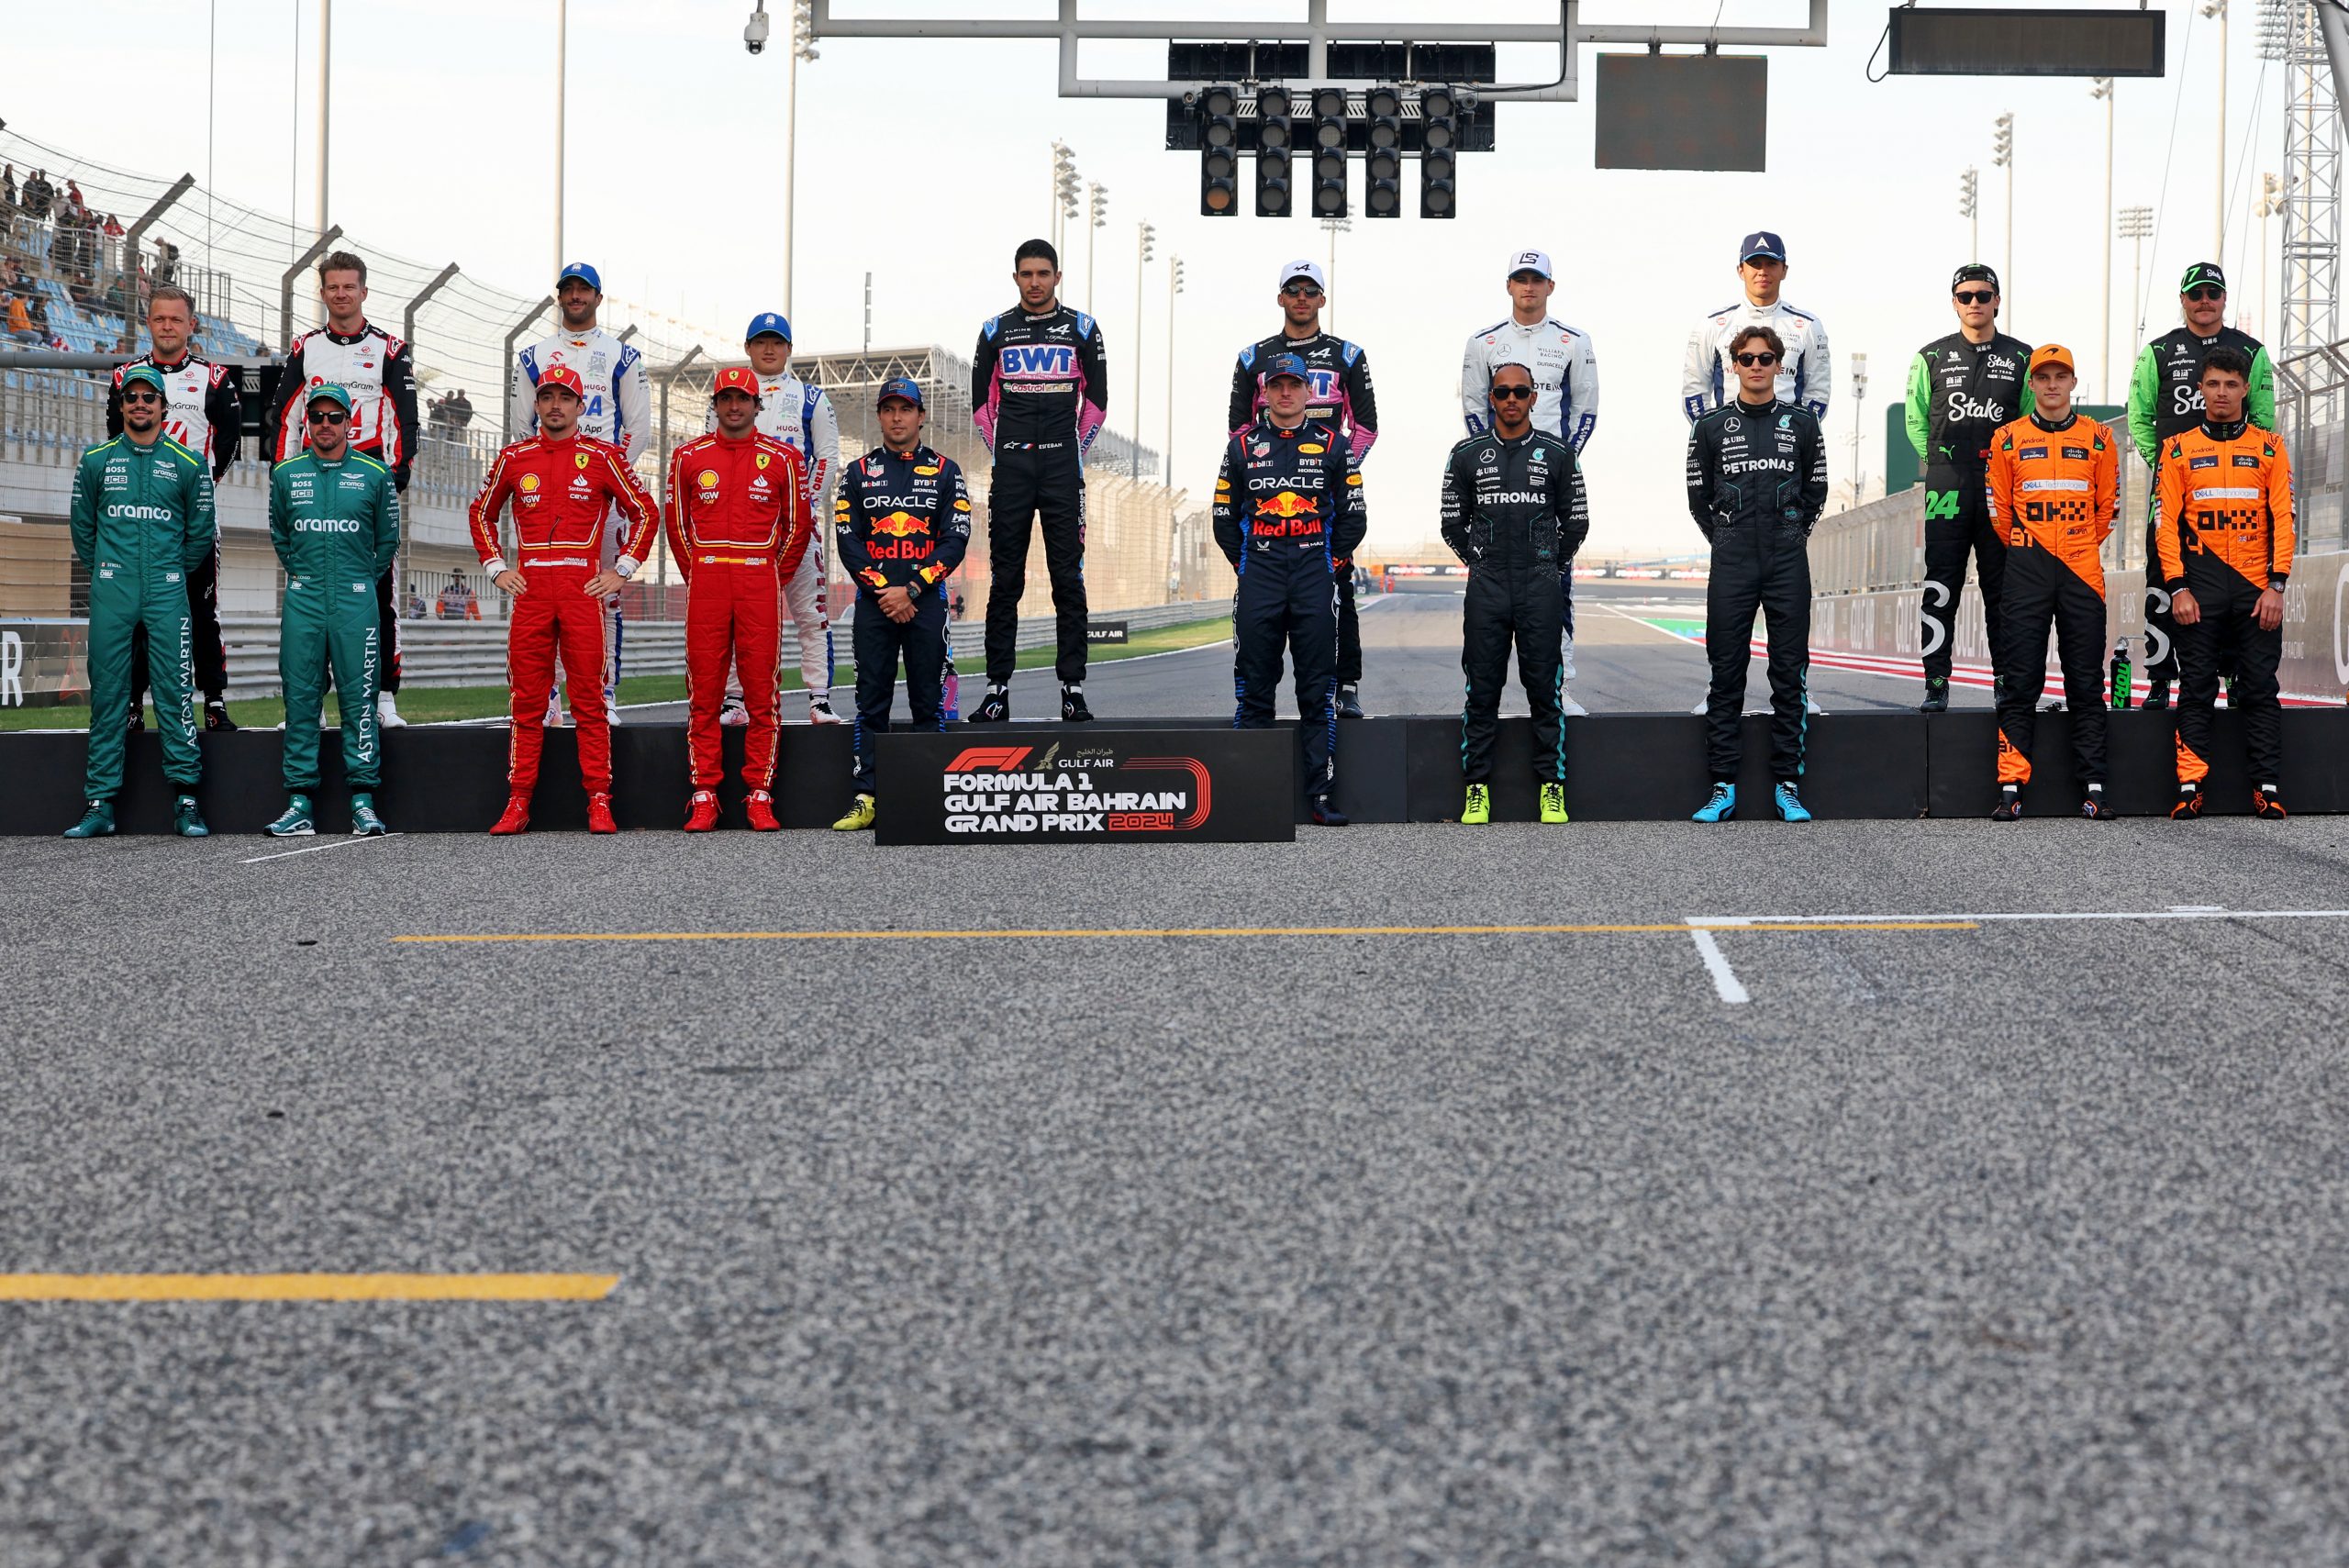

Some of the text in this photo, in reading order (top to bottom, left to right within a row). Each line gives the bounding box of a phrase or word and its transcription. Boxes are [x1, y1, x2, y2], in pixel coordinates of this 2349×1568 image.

[1002, 348, 1073, 373] BWT
[1537, 361, 1564, 370] DURACELL
[1987, 354, 2016, 371] Stake
[584, 384, 607, 393] HUGO
[1011, 383, 1044, 393] Castrol
[2174, 385, 2207, 416] Sta
[1948, 392, 2004, 422] Stake
[584, 424, 603, 434] App
[776, 425, 799, 433] HUGO
[1083, 424, 1099, 447] BWT
[1774, 433, 1797, 442] INEOS
[2021, 437, 2045, 445] Android
[2190, 446, 2215, 454] Android
[1247, 461, 1265, 469] Mobil
[1484, 466, 1498, 474] UBS
[1527, 465, 1549, 475] INEOS
[1722, 458, 1795, 475] PETRONAS
[152, 469, 178, 479] aramco
[815, 459, 828, 491] ORLEN
[105, 475, 128, 484] JCB
[862, 480, 881, 488] Mobil
[1249, 476, 1324, 491] ORACLE
[2023, 480, 2087, 490] DELL Technologies
[291, 490, 313, 498] JCB
[698, 491, 719, 501] VGW
[1476, 492, 1546, 505] PETRONAS
[2215, 489, 2257, 499] Technologies
[520, 495, 541, 504] VGW
[863, 495, 937, 509] ORACLE
[1925, 490, 1960, 520] 24
[107, 505, 172, 521] aramco
[2025, 500, 2087, 522] OKX
[2198, 510, 2257, 530] OKX
[294, 519, 360, 533] aramco
[1253, 518, 1321, 537] Red Bull
[866, 539, 934, 560] Red Bull
[704, 555, 716, 563] 55
[99, 570, 114, 579] OMP
[165, 573, 180, 582] OMP
[352, 583, 367, 592] OMP
[1087, 630, 1107, 639] GULF
[179, 617, 196, 748] ASTON MARTIN
[2113, 662, 2131, 708] ZHOU
[357, 627, 376, 763] ASTON MARTIN
[1076, 748, 1113, 758] طيران الخليج
[1058, 759, 1114, 768] GULF AIR
[943, 773, 1093, 792] FORMULA 1
[944, 792, 1186, 812] GULF AIR BAHRAIN
[945, 813, 1174, 832] GRAND PRIX 2024
